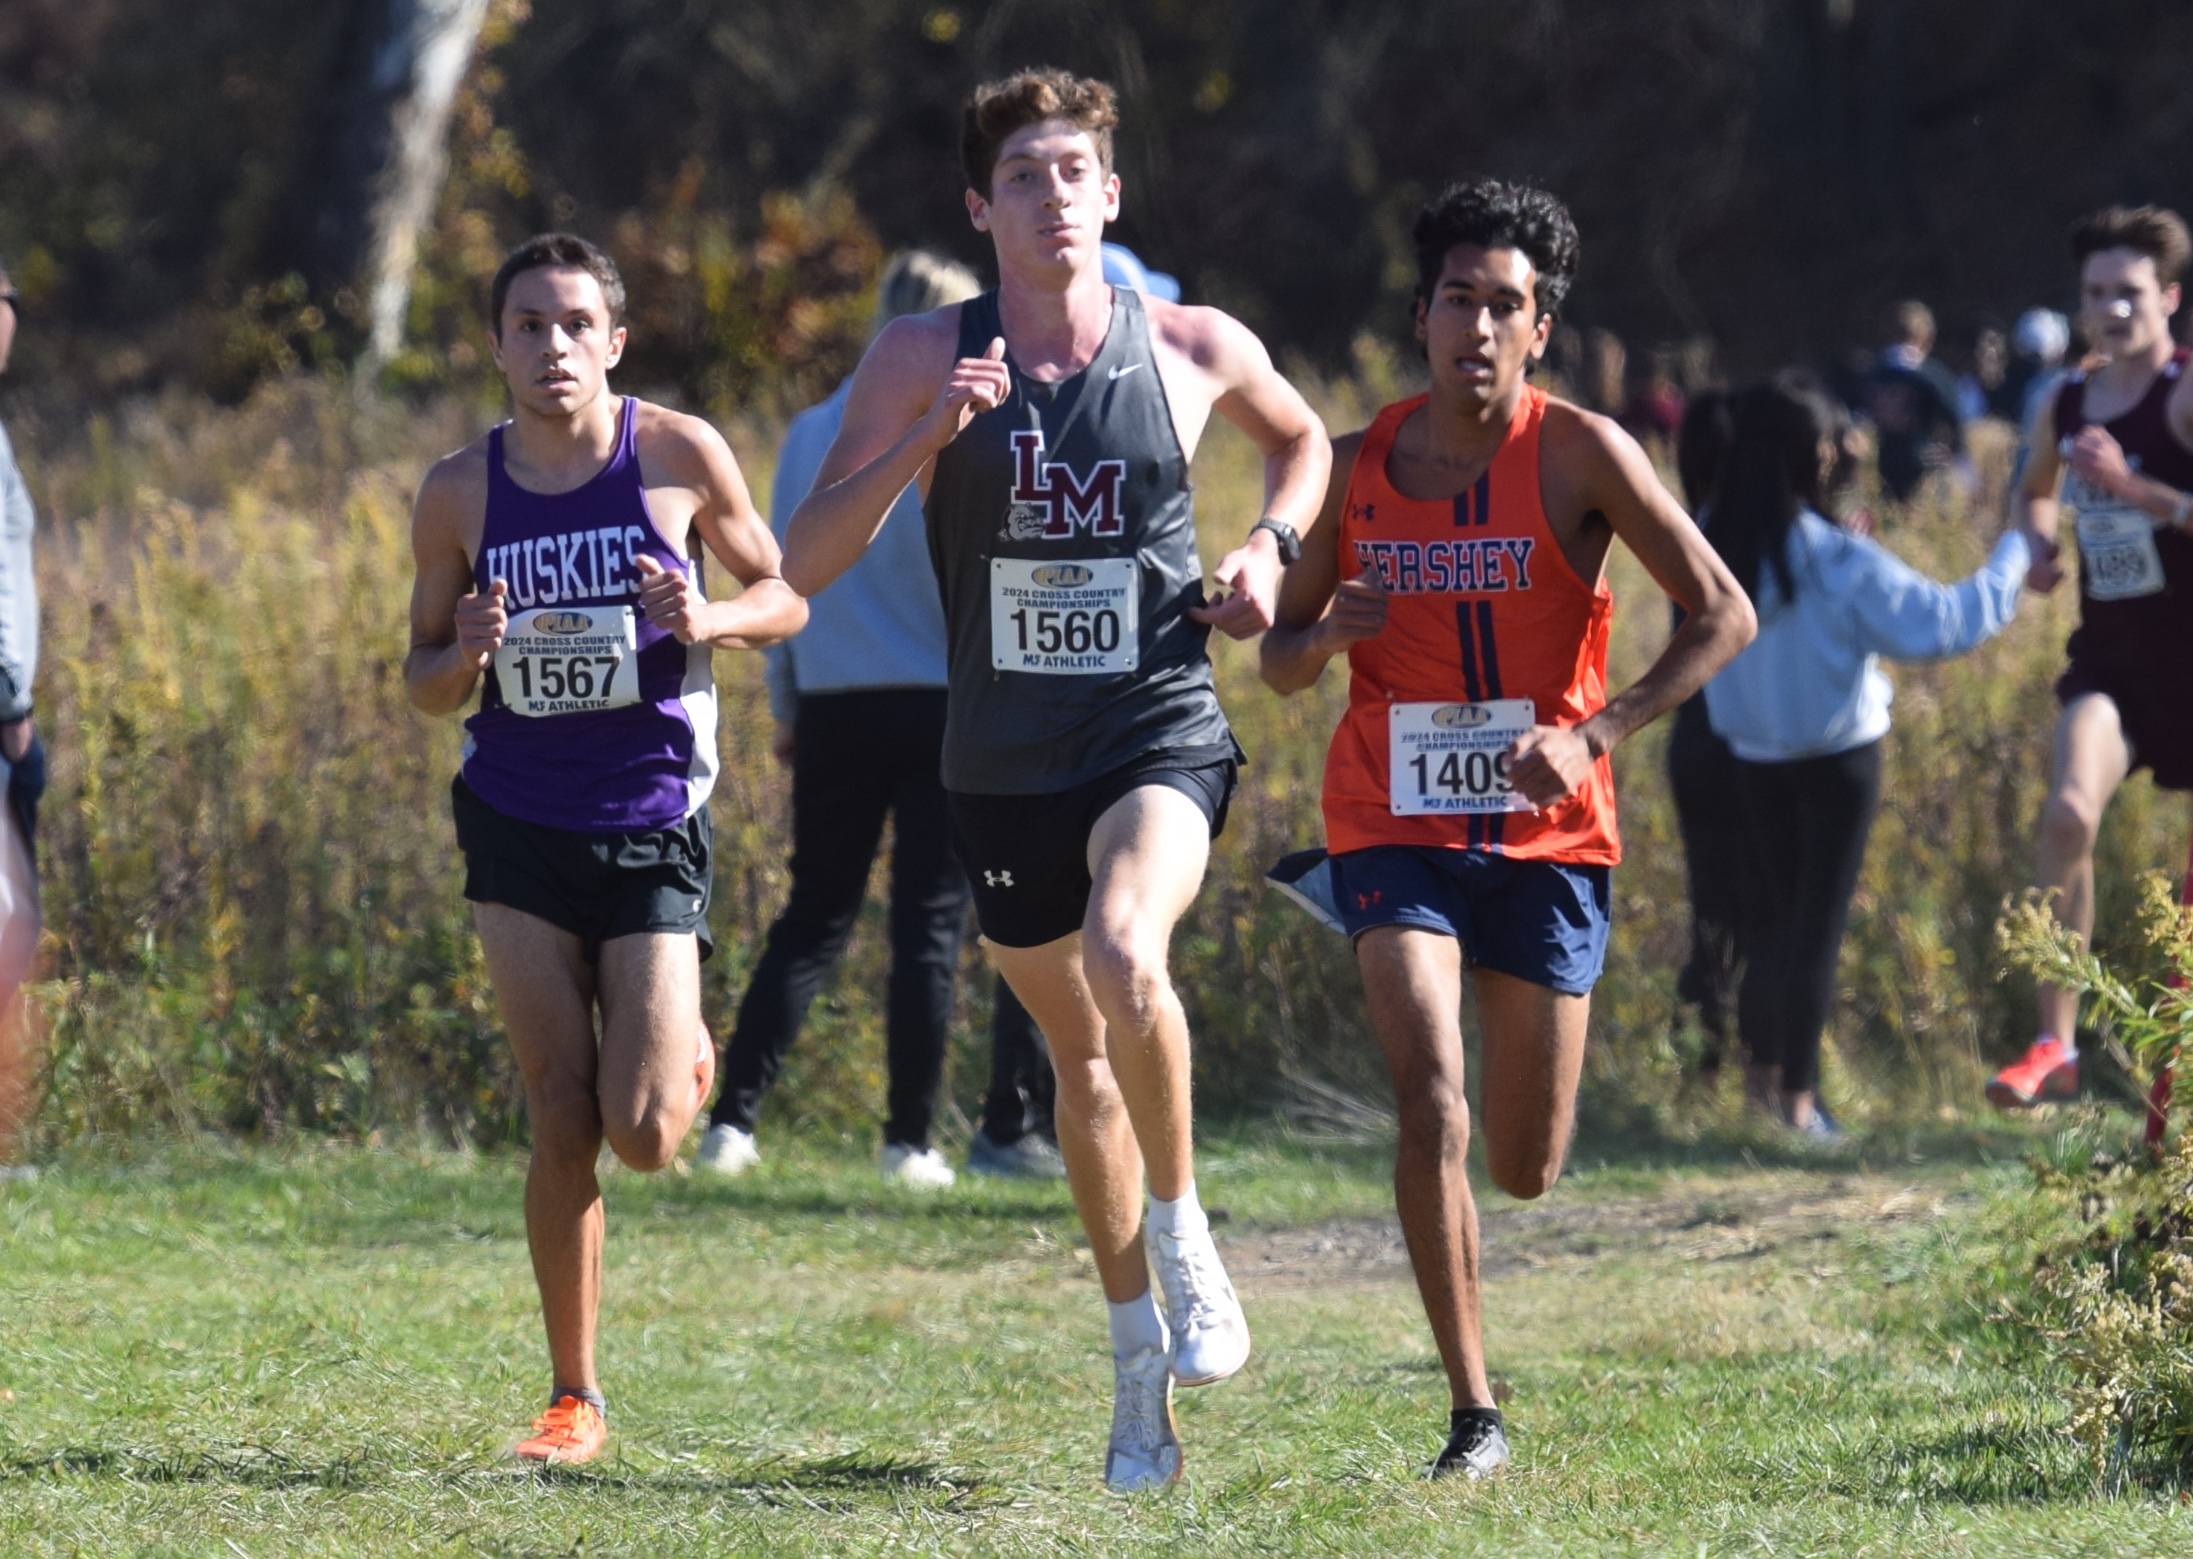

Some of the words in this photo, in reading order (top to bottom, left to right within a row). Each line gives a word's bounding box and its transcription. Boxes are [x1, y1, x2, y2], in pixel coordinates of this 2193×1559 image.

[1010, 430, 1126, 539] LM
[487, 525, 645, 609] HUSKIES
[1002, 587, 1029, 598] 2024
[1032, 589, 1071, 599] CROSS
[1073, 588, 1125, 598] COUNTRY
[1017, 598, 1111, 609] CHAMPIONSHIPS
[1010, 608, 1120, 654] 1560
[504, 636, 531, 646] 2024
[534, 636, 571, 646] CROSS
[574, 635, 626, 645] COUNTRY
[519, 646, 612, 656] CHAMPIONSHIPS
[1043, 655, 1106, 668] ATHLETIC
[512, 656, 620, 699] 1567
[549, 699, 610, 711] ATHLETIC
[1432, 731, 1470, 741] CROSS
[1445, 796, 1507, 809] ATHLETIC
